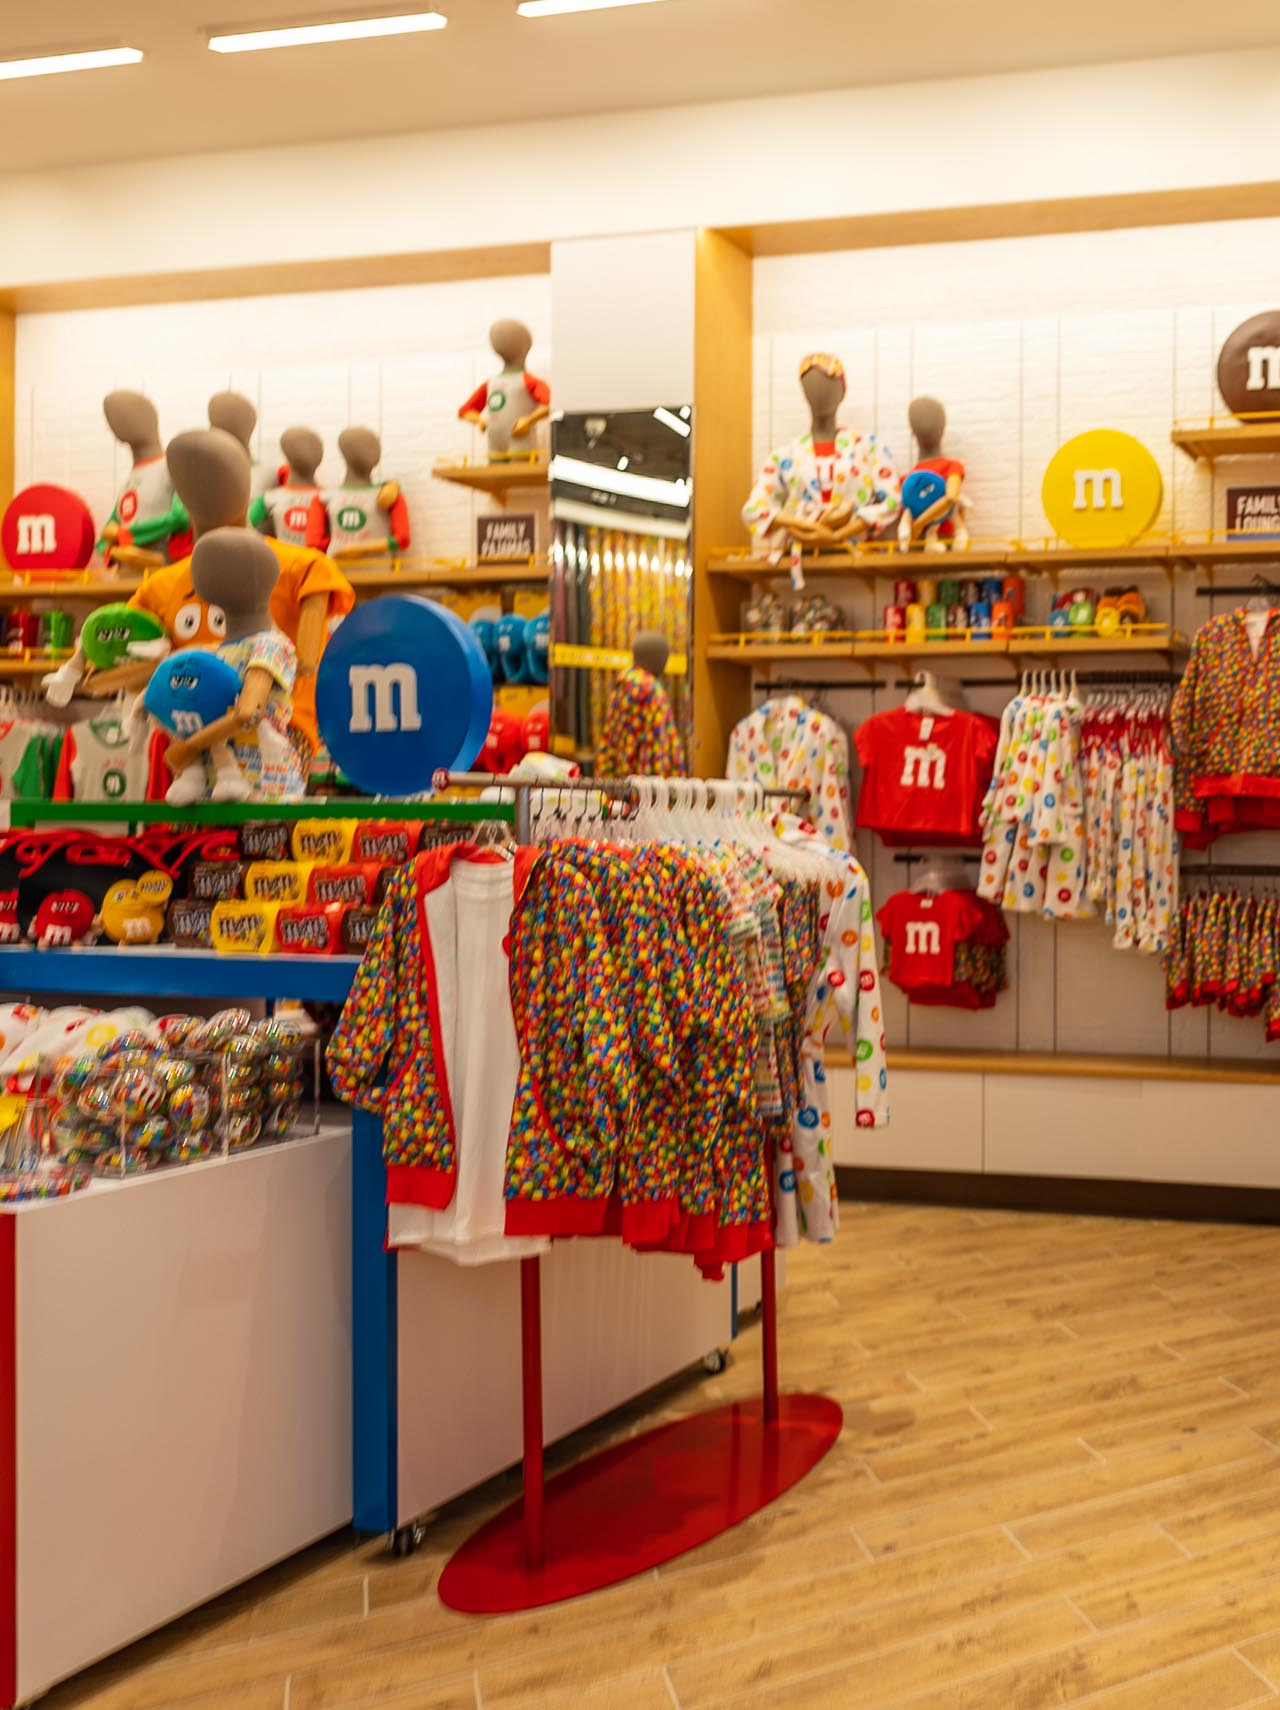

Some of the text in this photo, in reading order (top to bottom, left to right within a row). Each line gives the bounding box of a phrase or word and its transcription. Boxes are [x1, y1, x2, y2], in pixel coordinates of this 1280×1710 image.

[1073, 467, 1123, 510] m
[17, 513, 57, 554] m
[486, 520, 526, 541] FAMILY
[348, 661, 423, 733] m
[900, 741, 946, 790] m
[45, 923, 72, 946] m
[905, 920, 940, 955] m
